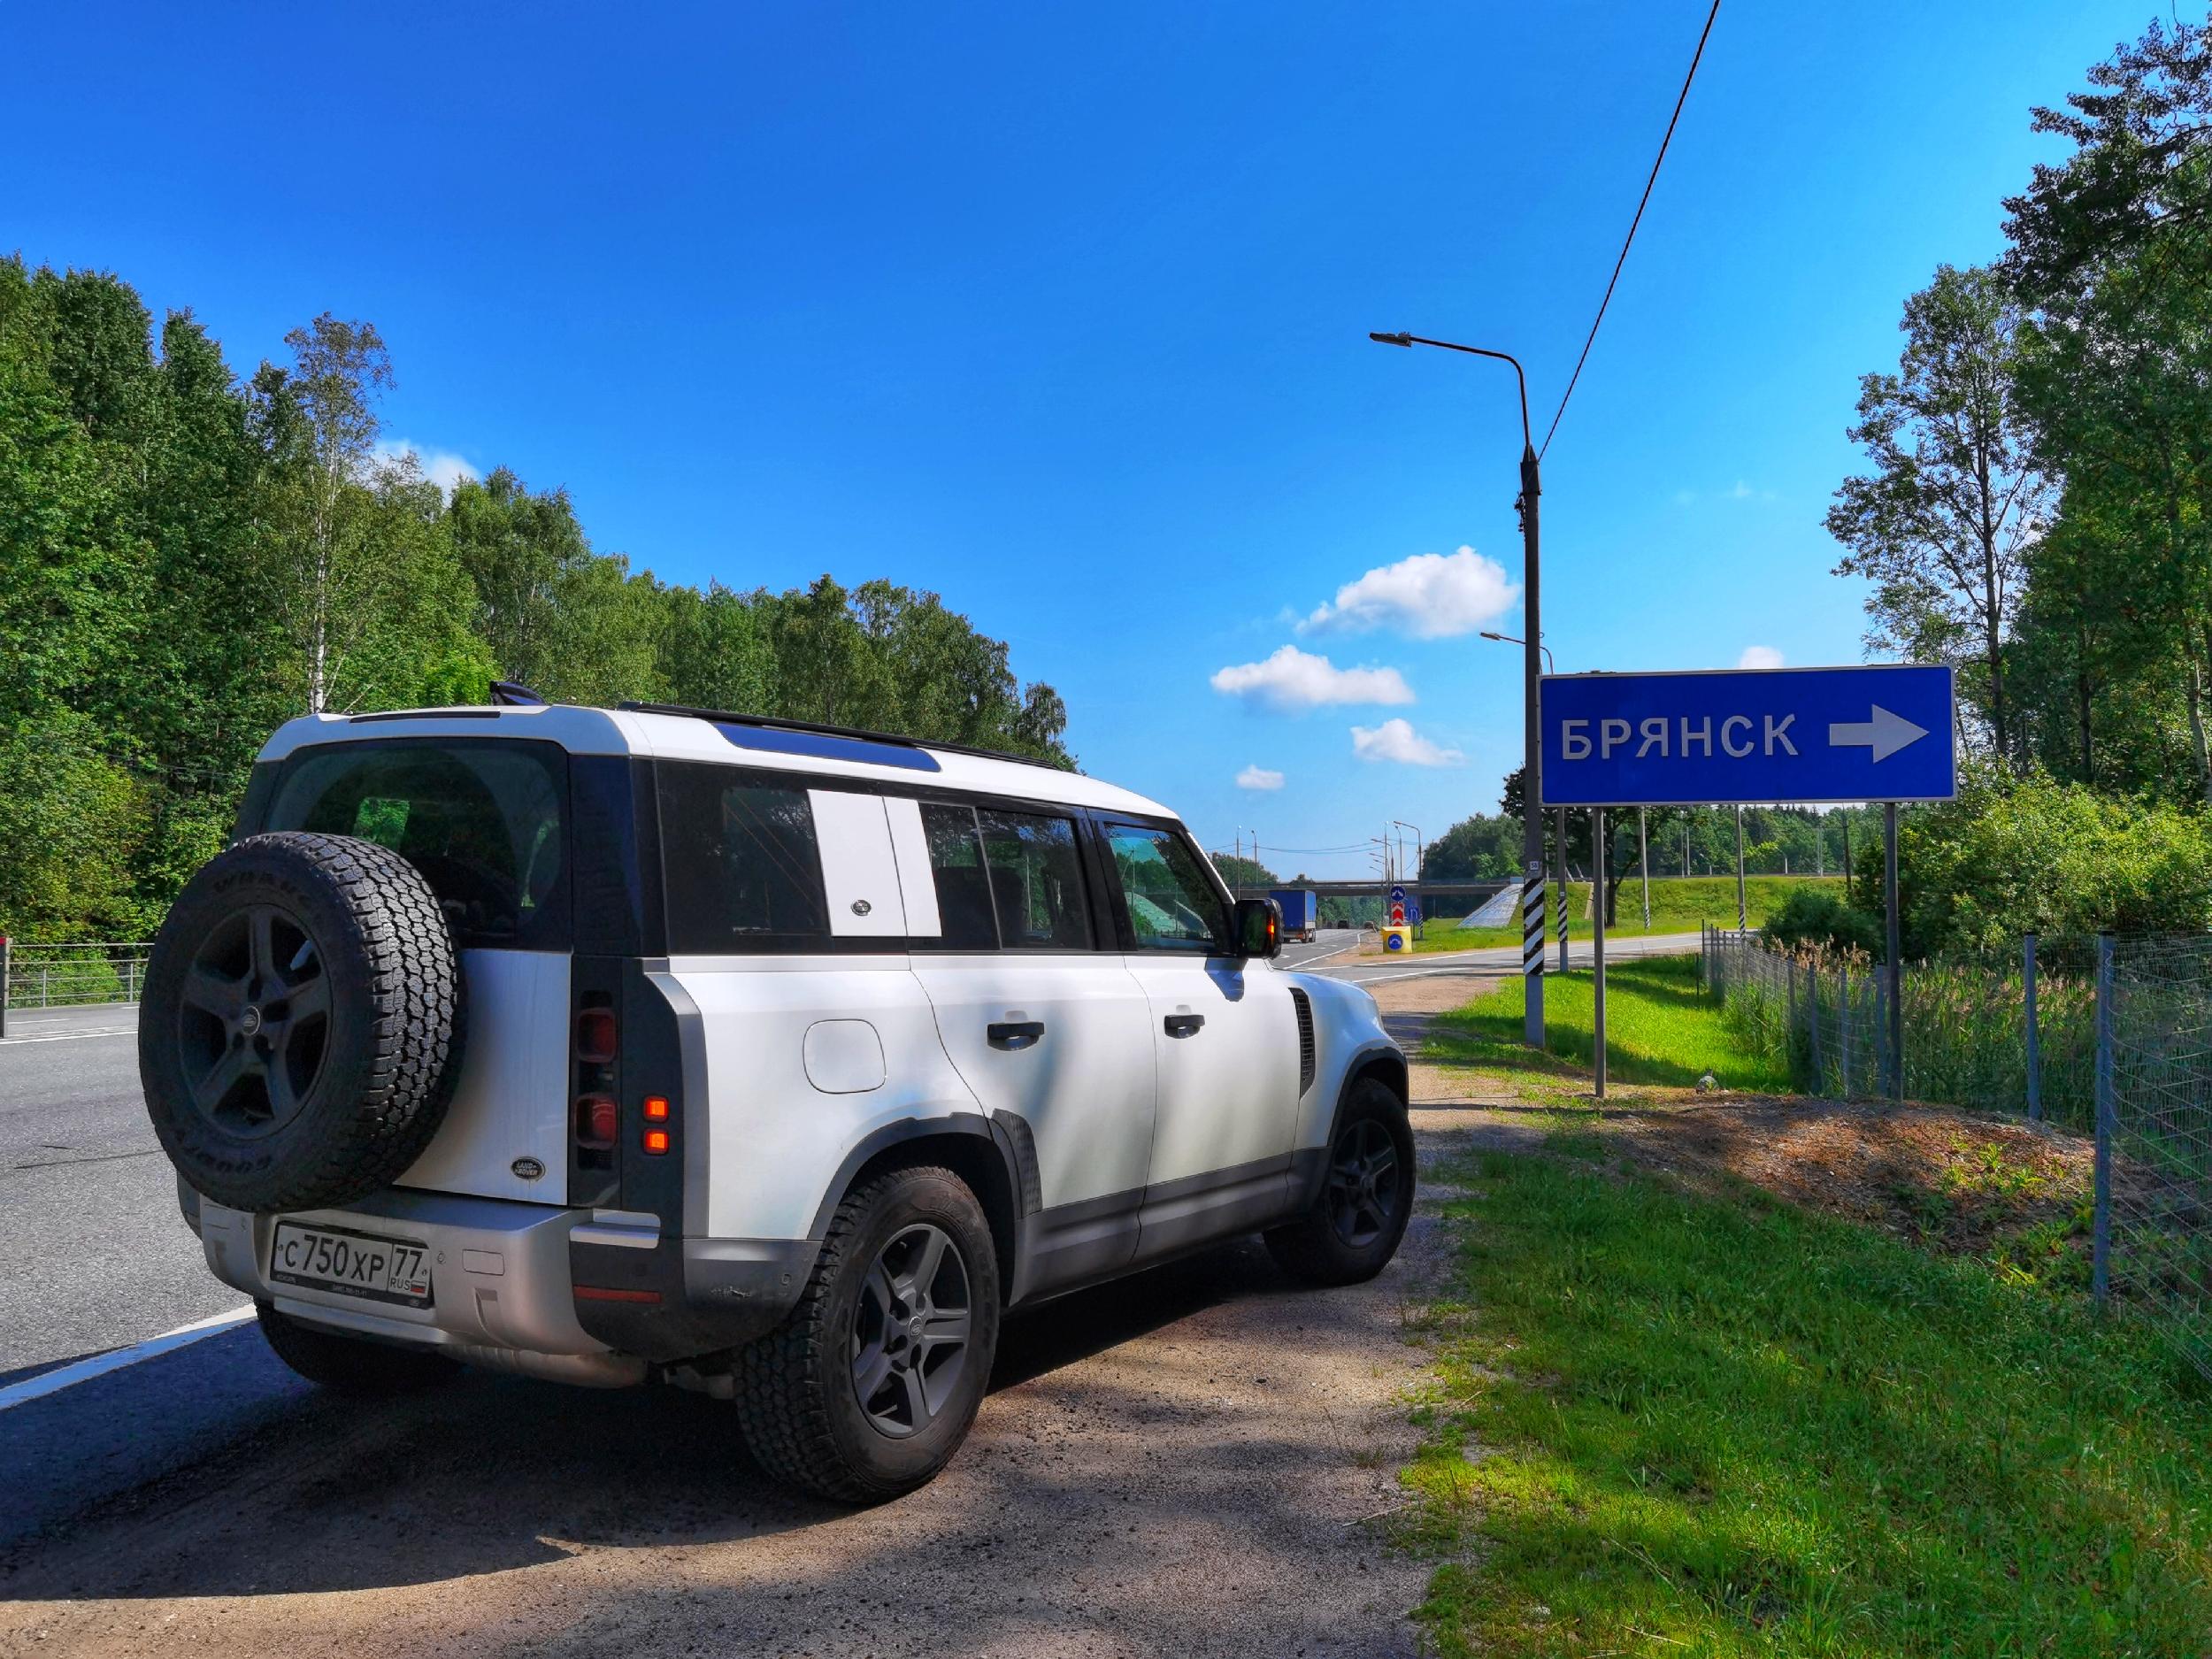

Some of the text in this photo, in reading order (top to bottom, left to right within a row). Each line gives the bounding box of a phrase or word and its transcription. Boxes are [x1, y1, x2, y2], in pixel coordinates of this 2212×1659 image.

[1562, 714, 1799, 761] БРЯНСК
[395, 1248, 425, 1280] 77
[391, 1278, 413, 1293] RUS
